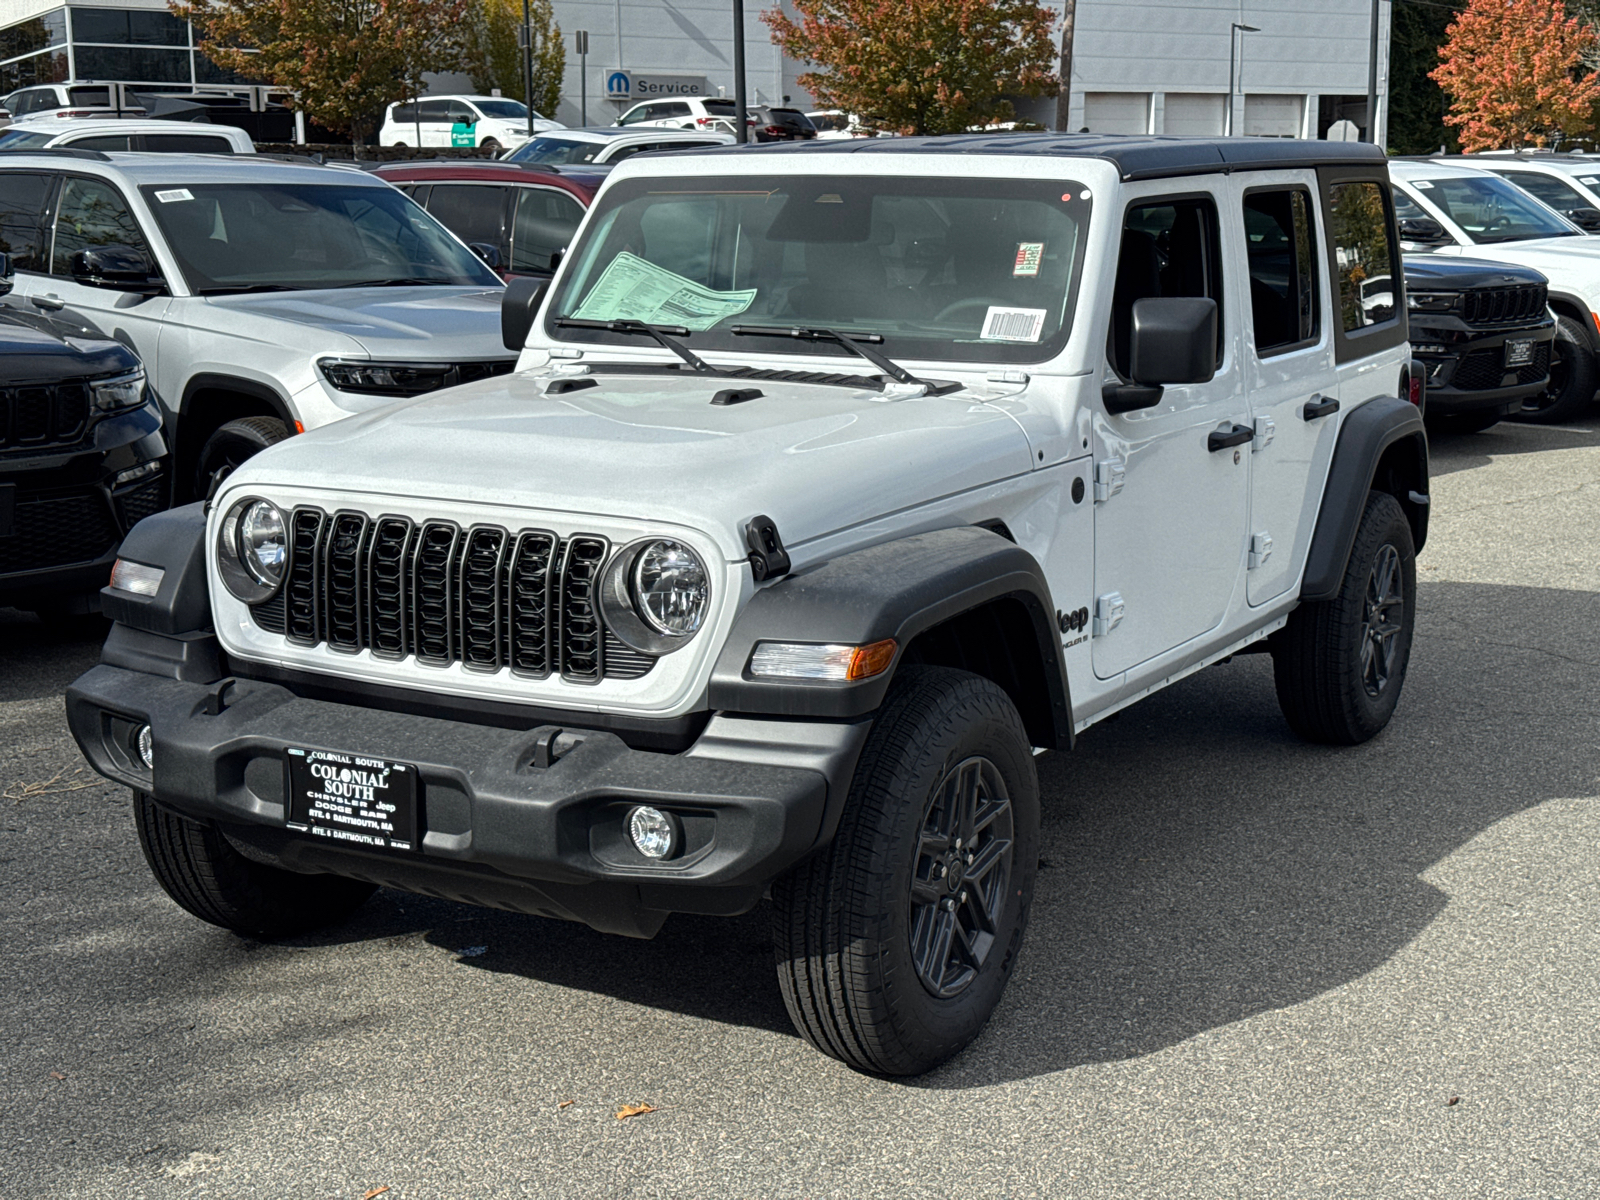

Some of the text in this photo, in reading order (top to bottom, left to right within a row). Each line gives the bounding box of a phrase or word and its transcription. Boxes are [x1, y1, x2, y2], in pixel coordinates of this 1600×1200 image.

[638, 80, 699, 94] Service
[312, 751, 352, 764] COLONIAL
[355, 757, 385, 768] SOUTH
[311, 763, 389, 788] COLONIAL
[324, 780, 375, 801] SOUTH
[306, 791, 396, 812] CHRYSLER Jeep
[315, 800, 387, 820] DODGE RAM
[333, 813, 380, 830] DARTMOUTH,
[381, 822, 394, 831] MA
[333, 831, 374, 846] DARTMOUTH,
[375, 838, 385, 846] MA
